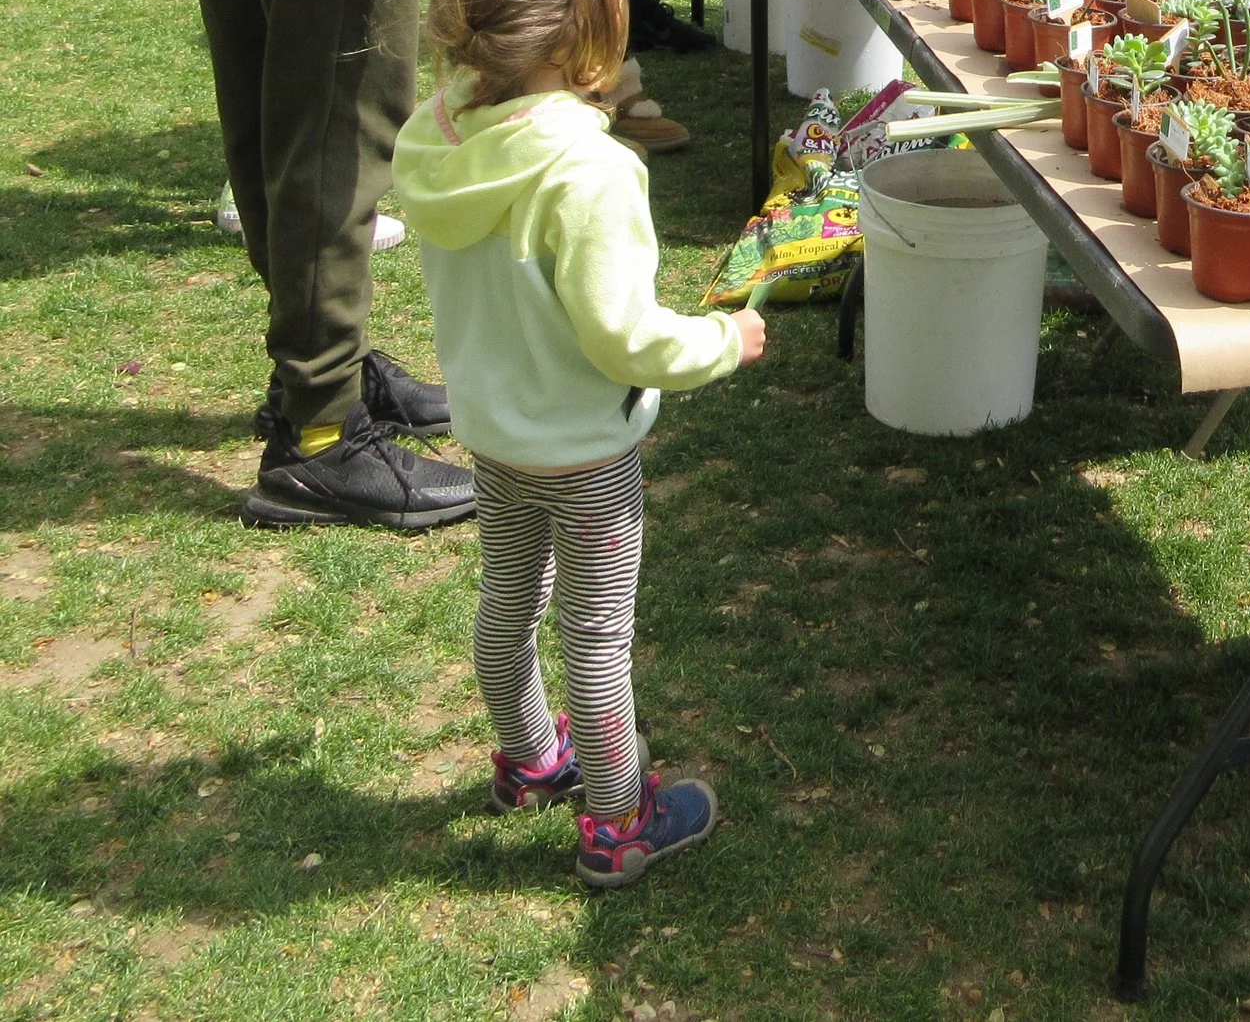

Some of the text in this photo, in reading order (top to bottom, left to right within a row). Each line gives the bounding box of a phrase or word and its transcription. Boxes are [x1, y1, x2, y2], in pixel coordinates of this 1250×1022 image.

[797, 240, 838, 255] Tropical
[771, 266, 821, 277] CUBIC FEET
